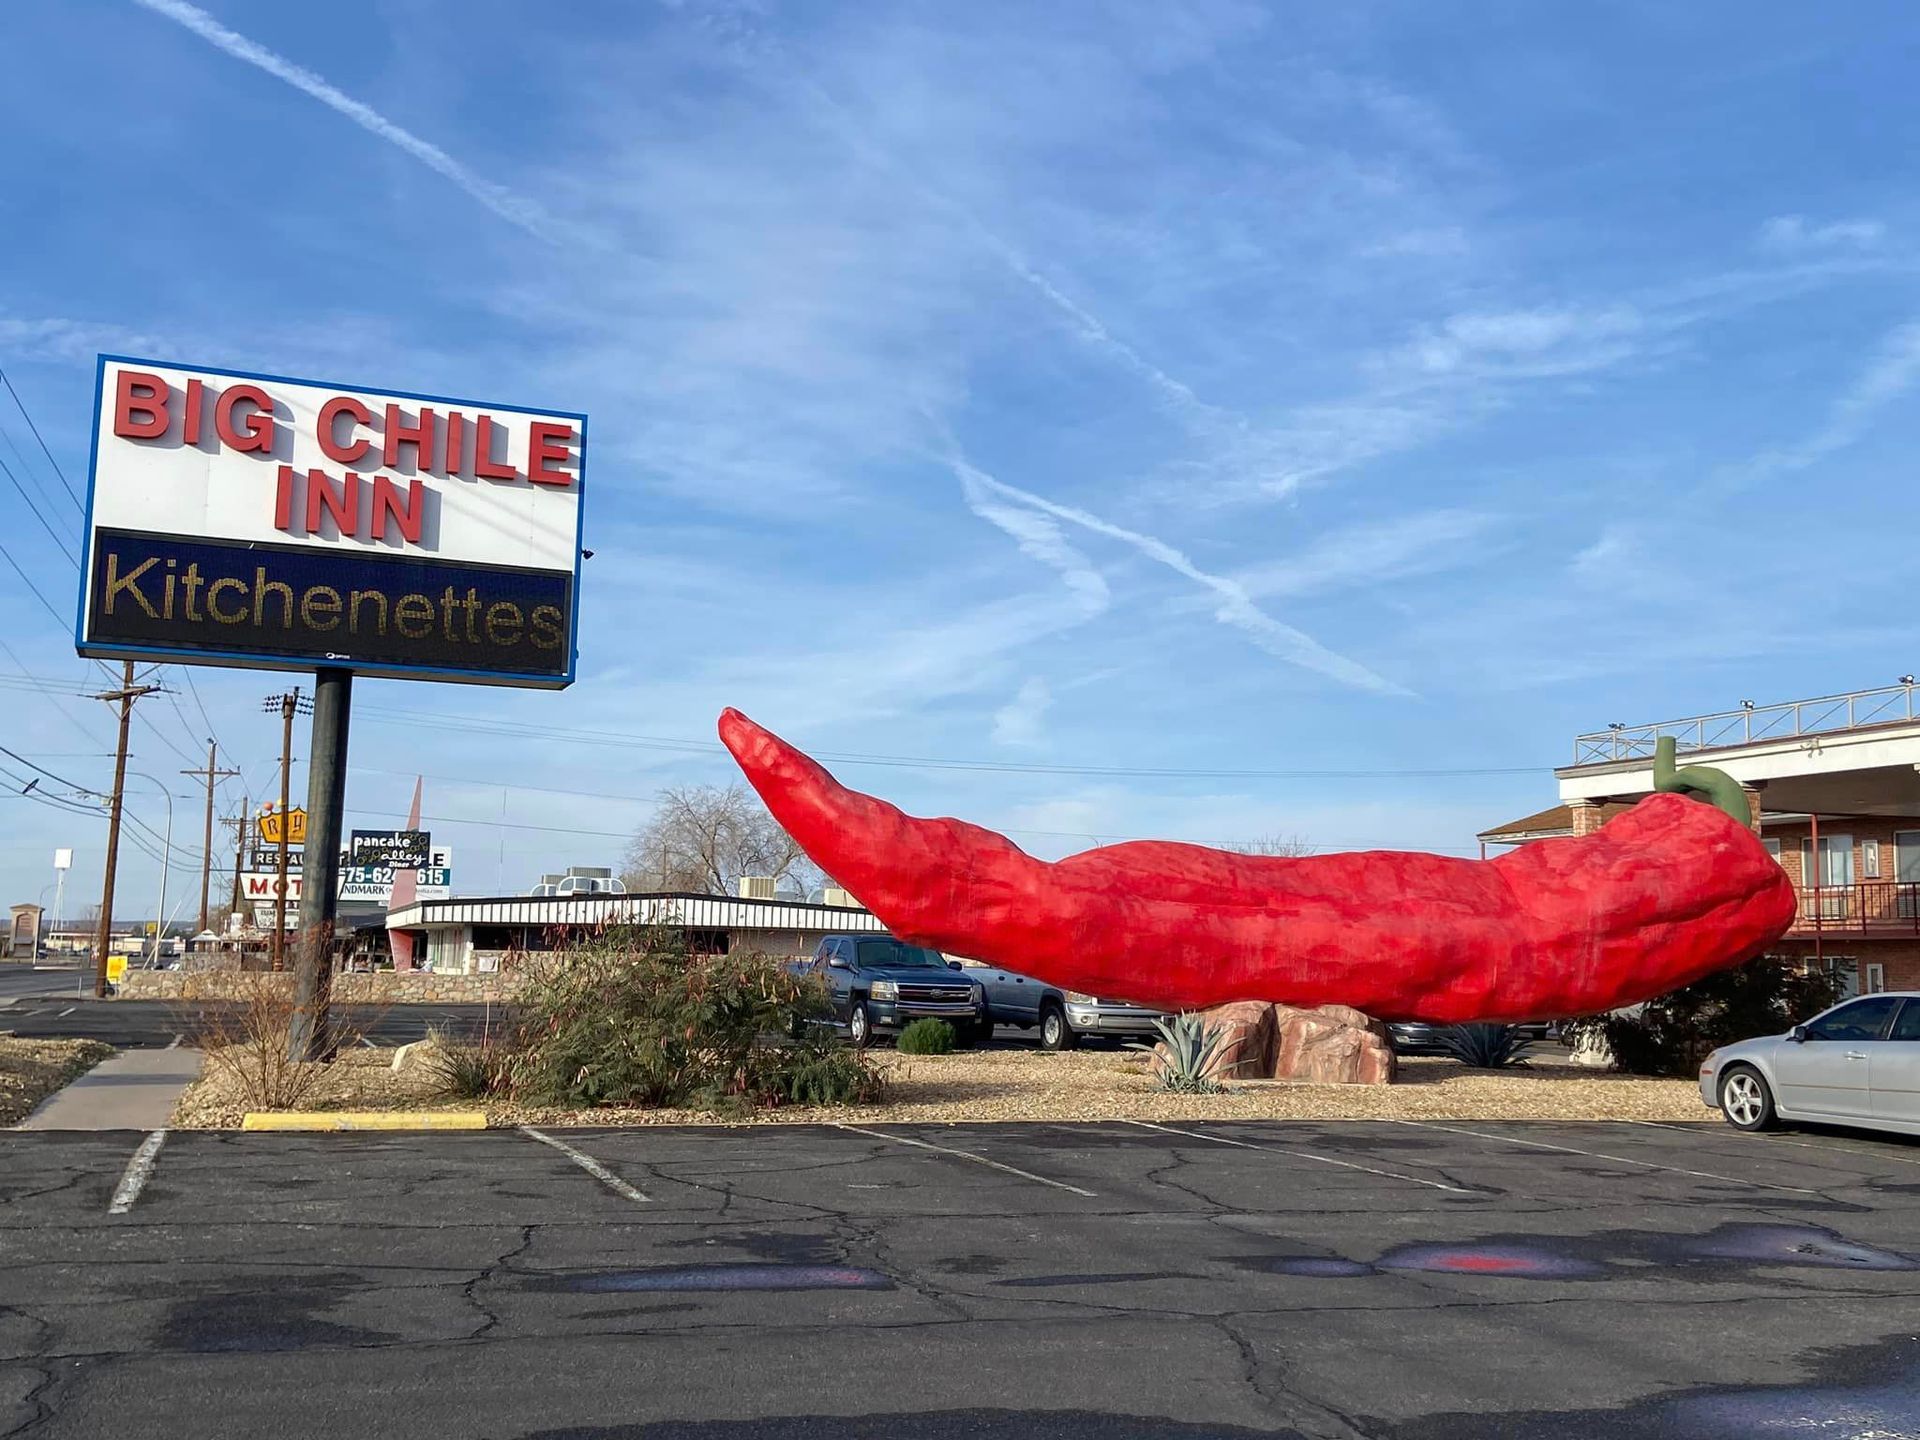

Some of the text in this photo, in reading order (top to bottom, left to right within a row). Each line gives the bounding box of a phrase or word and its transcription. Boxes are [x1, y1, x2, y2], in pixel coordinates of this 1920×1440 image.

[114, 369, 572, 486] BIG CHILE
[274, 464, 424, 543] INN
[104, 553, 564, 650] Kitchenettes
[354, 832, 411, 857] pancake
[381, 850, 427, 866] alley
